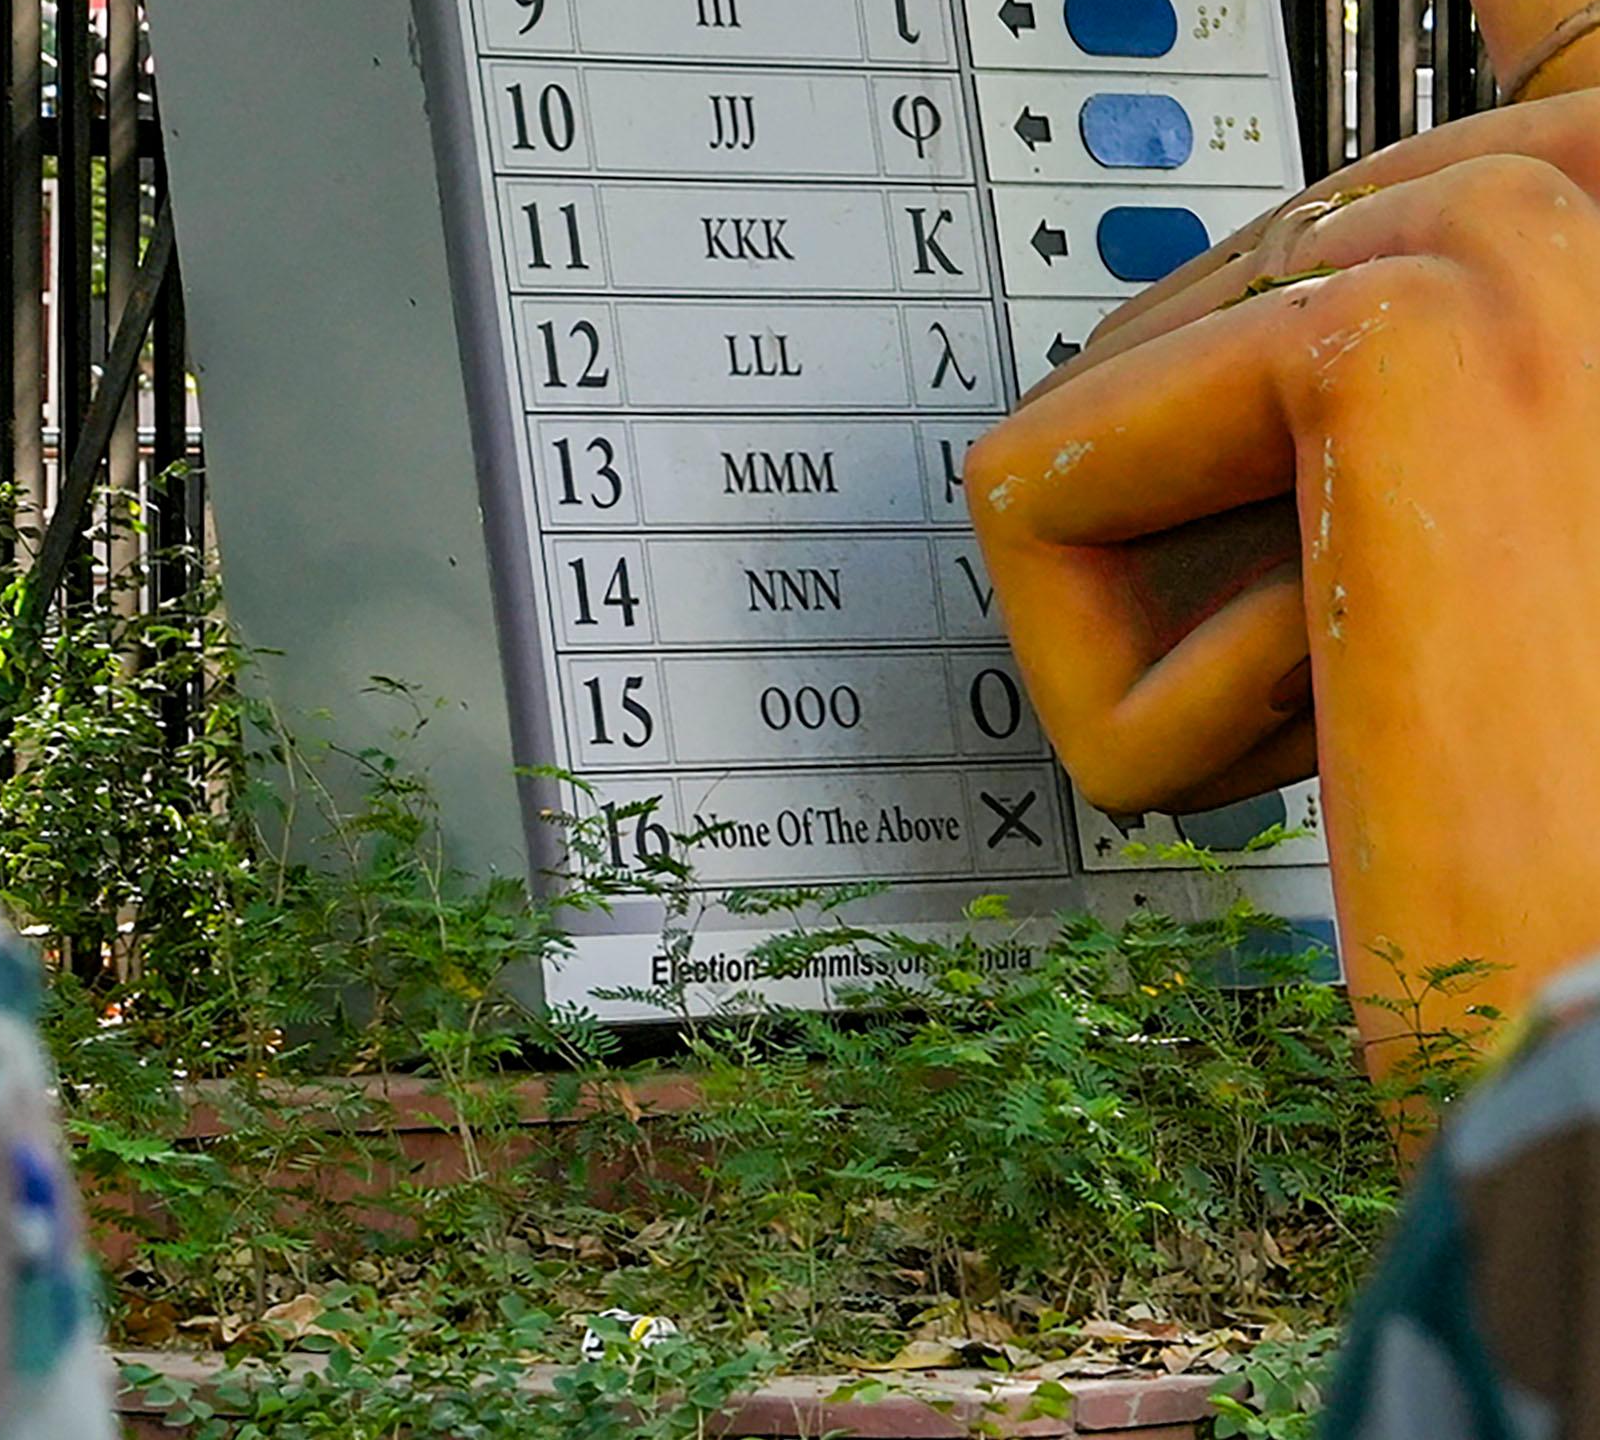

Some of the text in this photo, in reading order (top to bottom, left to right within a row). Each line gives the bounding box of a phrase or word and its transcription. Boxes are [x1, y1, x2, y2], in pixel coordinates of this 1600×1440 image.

[506, 84, 574, 151] 10
[710, 96, 754, 149] JJJ
[522, 203, 589, 269] 11
[701, 218, 794, 259] KKK
[538, 321, 609, 387] 12
[726, 336, 801, 376] LLL
[553, 438, 838, 508] 13 MMM
[568, 557, 639, 626] 14
[745, 569, 841, 611] NNN
[584, 677, 652, 747] 15
[761, 686, 861, 730] OOO
[694, 813, 769, 849] None
[778, 806, 814, 847] Of
[816, 809, 869, 845] The
[874, 809, 960, 844] Above
